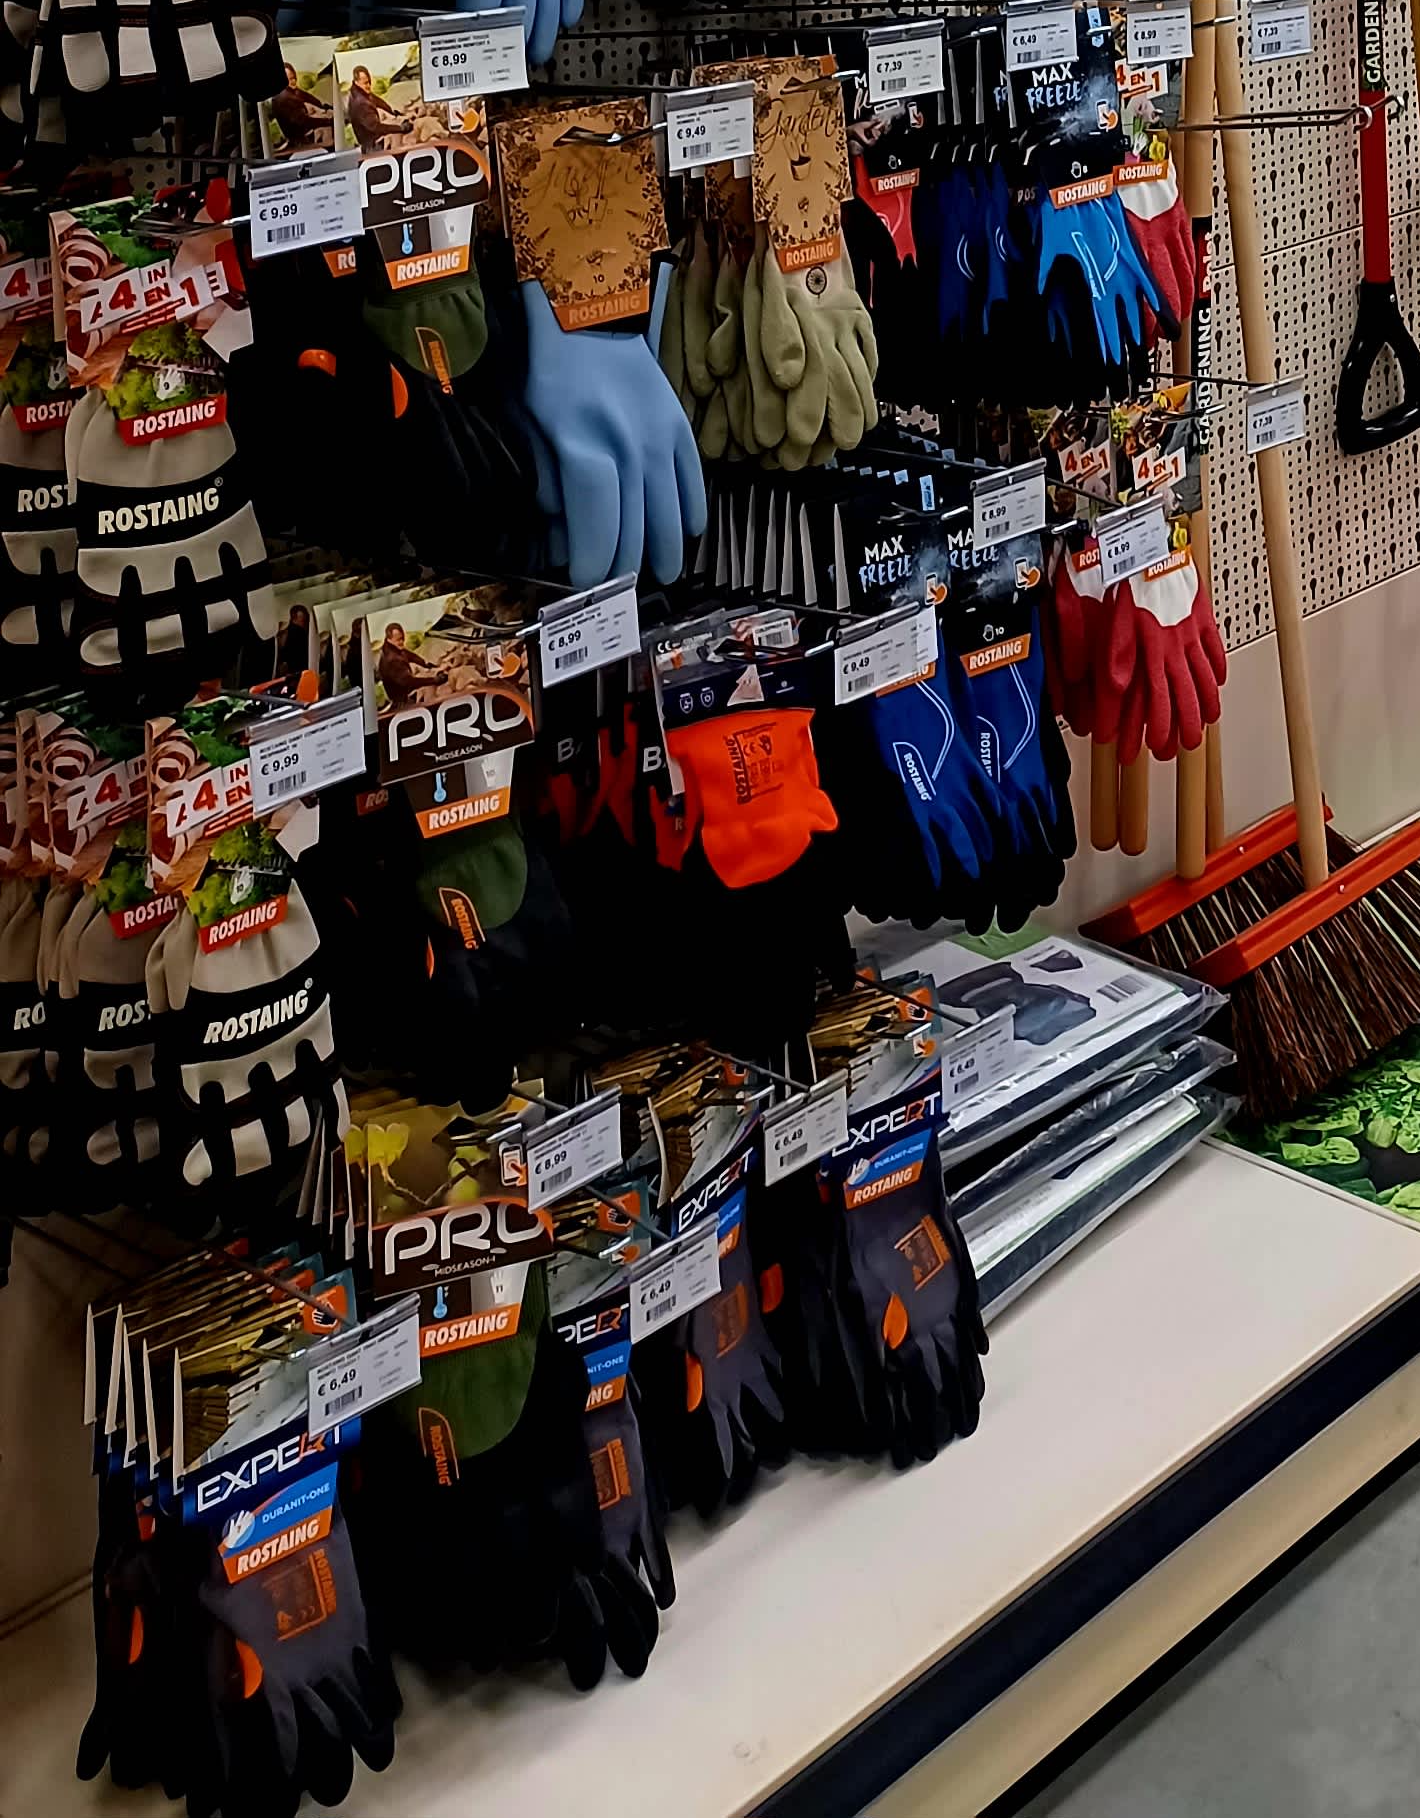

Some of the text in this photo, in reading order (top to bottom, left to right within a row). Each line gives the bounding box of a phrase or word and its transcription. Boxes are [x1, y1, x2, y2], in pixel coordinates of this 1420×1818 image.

[432, 53, 468, 68] € 8,99
[883, 61, 902, 73] 7,39
[1031, 63, 1073, 85] MAX
[1130, 72, 1146, 85] EN
[1151, 66, 1162, 92] 1
[1025, 82, 1082, 113] FREEZE
[684, 125, 706, 138] 9,49
[877, 175, 917, 191] ROSTAING
[1118, 165, 1163, 181] ROSTAING
[1057, 181, 1107, 204] ROSTAING
[270, 202, 298, 221] 9,99
[402, 198, 445, 213] MIDSEASON
[785, 239, 834, 264] ROSTAING
[397, 253, 460, 281] ROSTAING
[109, 279, 137, 311] 4
[144, 284, 171, 306] EN
[568, 293, 642, 326] ROSTAING
[26, 400, 76, 423] ROSTA
[133, 401, 217, 437] ROSTAING
[1065, 449, 1109, 471] 4 EN 1
[1138, 457, 1180, 479] 4 EN 1
[988, 506, 1006, 520] 8,99
[864, 535, 904, 564] MAX
[859, 554, 912, 593] FREEZE
[557, 630, 581, 647] 8,99
[850, 658, 870, 672] 9,49
[970, 641, 1022, 671] ROSTAING
[272, 753, 299, 773] 9,99
[436, 744, 483, 762] MIDSEASON
[904, 752, 932, 801] ROSTAING
[192, 779, 219, 811] 4
[429, 794, 500, 830] ROSTAING
[124, 896, 178, 929] ROSTA
[208, 901, 279, 945] ROSTAING
[782, 1129, 803, 1147] 6,49
[543, 1150, 567, 1170] 8,99
[678, 1147, 754, 1232] EXPERT
[853, 1169, 913, 1203] ROSTAING
[649, 1280, 671, 1300] 6,49
[424, 1313, 509, 1349] ROSTAING
[329, 1369, 356, 1391] 6,49
[262, 1482, 330, 1523] DURANIT-ONE
[237, 1519, 320, 1574] ROSTAING
